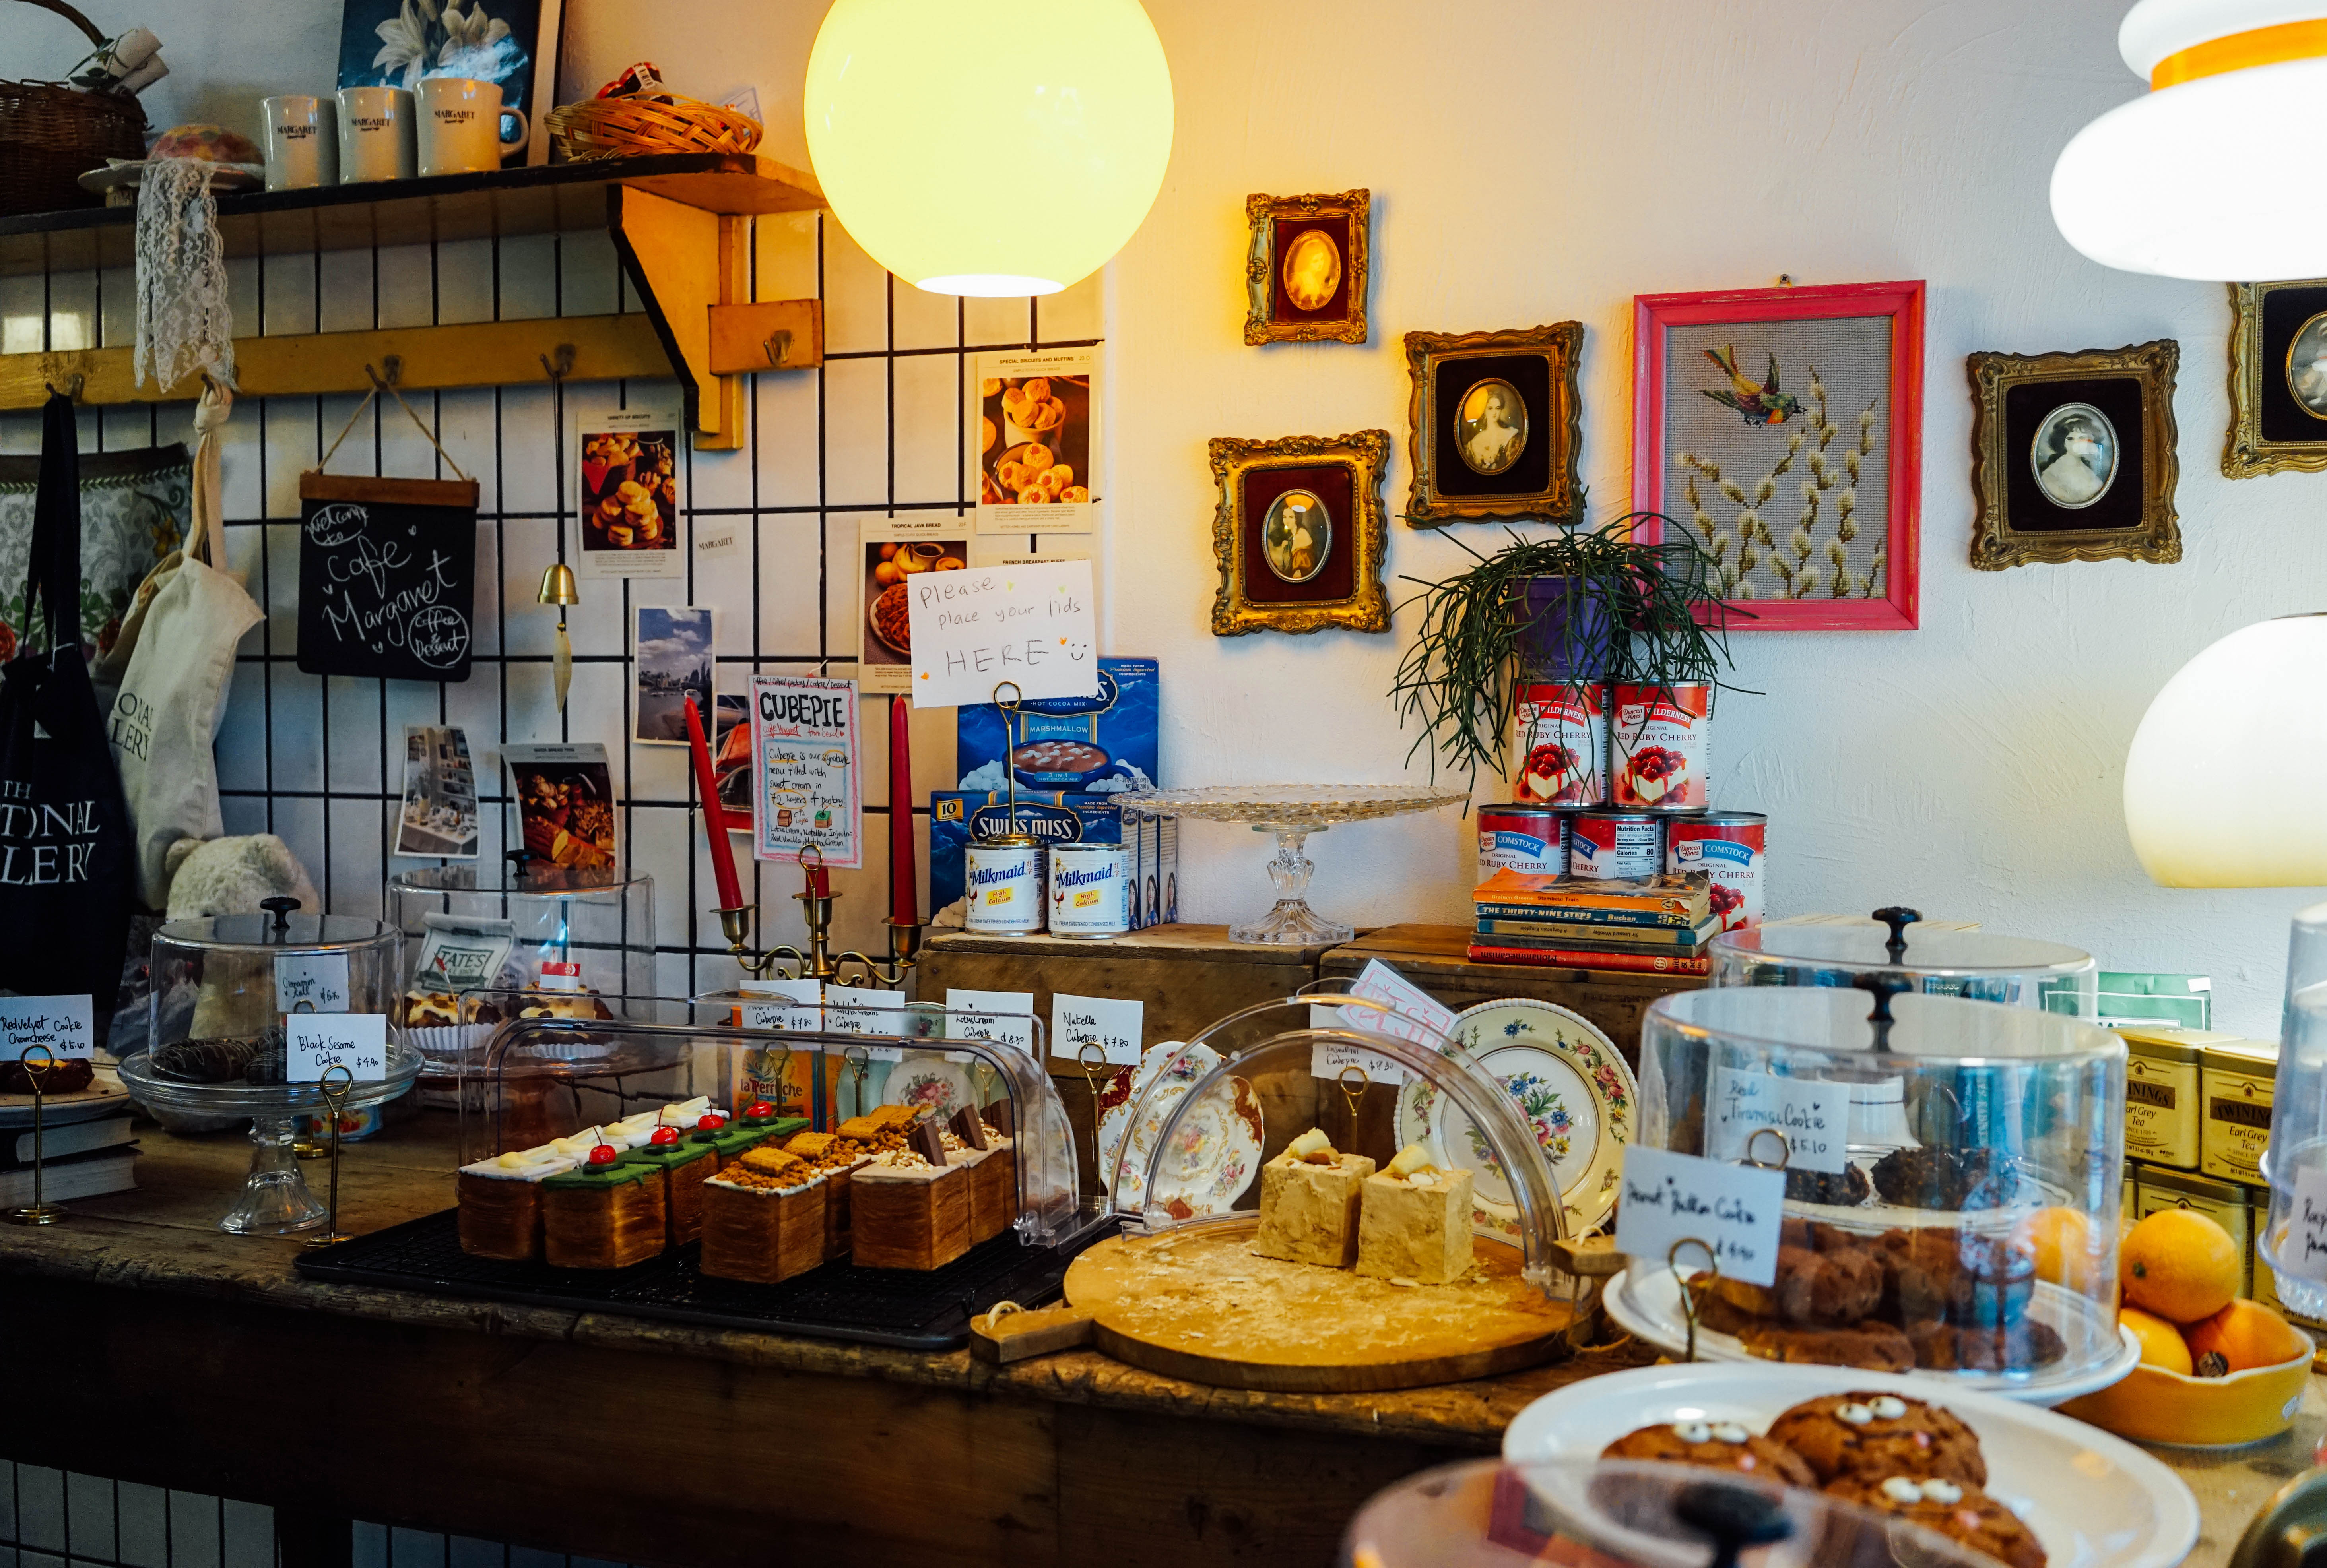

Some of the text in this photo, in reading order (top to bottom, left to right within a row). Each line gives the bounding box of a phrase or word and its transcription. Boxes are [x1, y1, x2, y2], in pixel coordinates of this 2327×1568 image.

[435, 110, 476, 119] MARGARET
[351, 118, 391, 127] MARGARET
[278, 126, 317, 135] MARGARET
[699, 536, 734, 550] MARGARET
[322, 549, 458, 646] Margaret
[939, 595, 1081, 630] place your lids
[946, 640, 1049, 676] HERE
[760, 692, 846, 728] CUBEPIE
[1540, 706, 1585, 722] WILDERNESS
[1646, 707, 1691, 723] WILDERNESS
[1515, 729, 1525, 738] RED
[1554, 731, 1591, 739] CHERRY
[1617, 731, 1630, 740] RED
[1660, 733, 1697, 741] CHERRY
[769, 747, 796, 764] Cubepie
[800, 751, 805, 761] is
[822, 753, 850, 766] signature
[788, 764, 807, 776] filled
[808, 769, 826, 778] with
[770, 777, 790, 790] sweet
[810, 791, 819, 806] of
[821, 795, 843, 808] pastry
[941, 802, 957, 814] 10
[1031, 818, 1073, 839] MISS
[1497, 836, 1540, 852] COMSTOCK
[1705, 845, 1749, 861] COMSTOCK
[1026, 860, 1033, 875] 红字
[1114, 862, 1120, 877] 红字
[1487, 859, 1548, 869] RUBY CHERRY
[1572, 862, 1599, 872] CHERRY
[972, 861, 1025, 886] Milkmaid
[1058, 863, 1113, 888] Milkmaid
[988, 896, 1011, 904] Calcium
[1075, 898, 1098, 907] Calcium
[1502, 907, 1562, 917] THIRTY-NINE
[1563, 911, 1591, 919] STEPS
[441, 950, 487, 968] TATE'S
[54, 1016, 82, 1033] Cookie
[755, 1012, 784, 1025] Cubepie
[835, 1016, 861, 1033] Cubepie
[1063, 1012, 1097, 1026] Nutella
[964, 1026, 991, 1038] Cubepie
[1066, 1029, 1098, 1045] Cubepie
[297, 1034, 355, 1052] Black Sesame
[315, 1051, 342, 1067] Cookie
[1784, 1103, 1825, 1129] Cookie
[2138, 1106, 2156, 1120] Grey
[2132, 1116, 2145, 1127] Tea
[2230, 1126, 2268, 1144] Earl Grey
[2241, 1139, 2255, 1151] Tea
